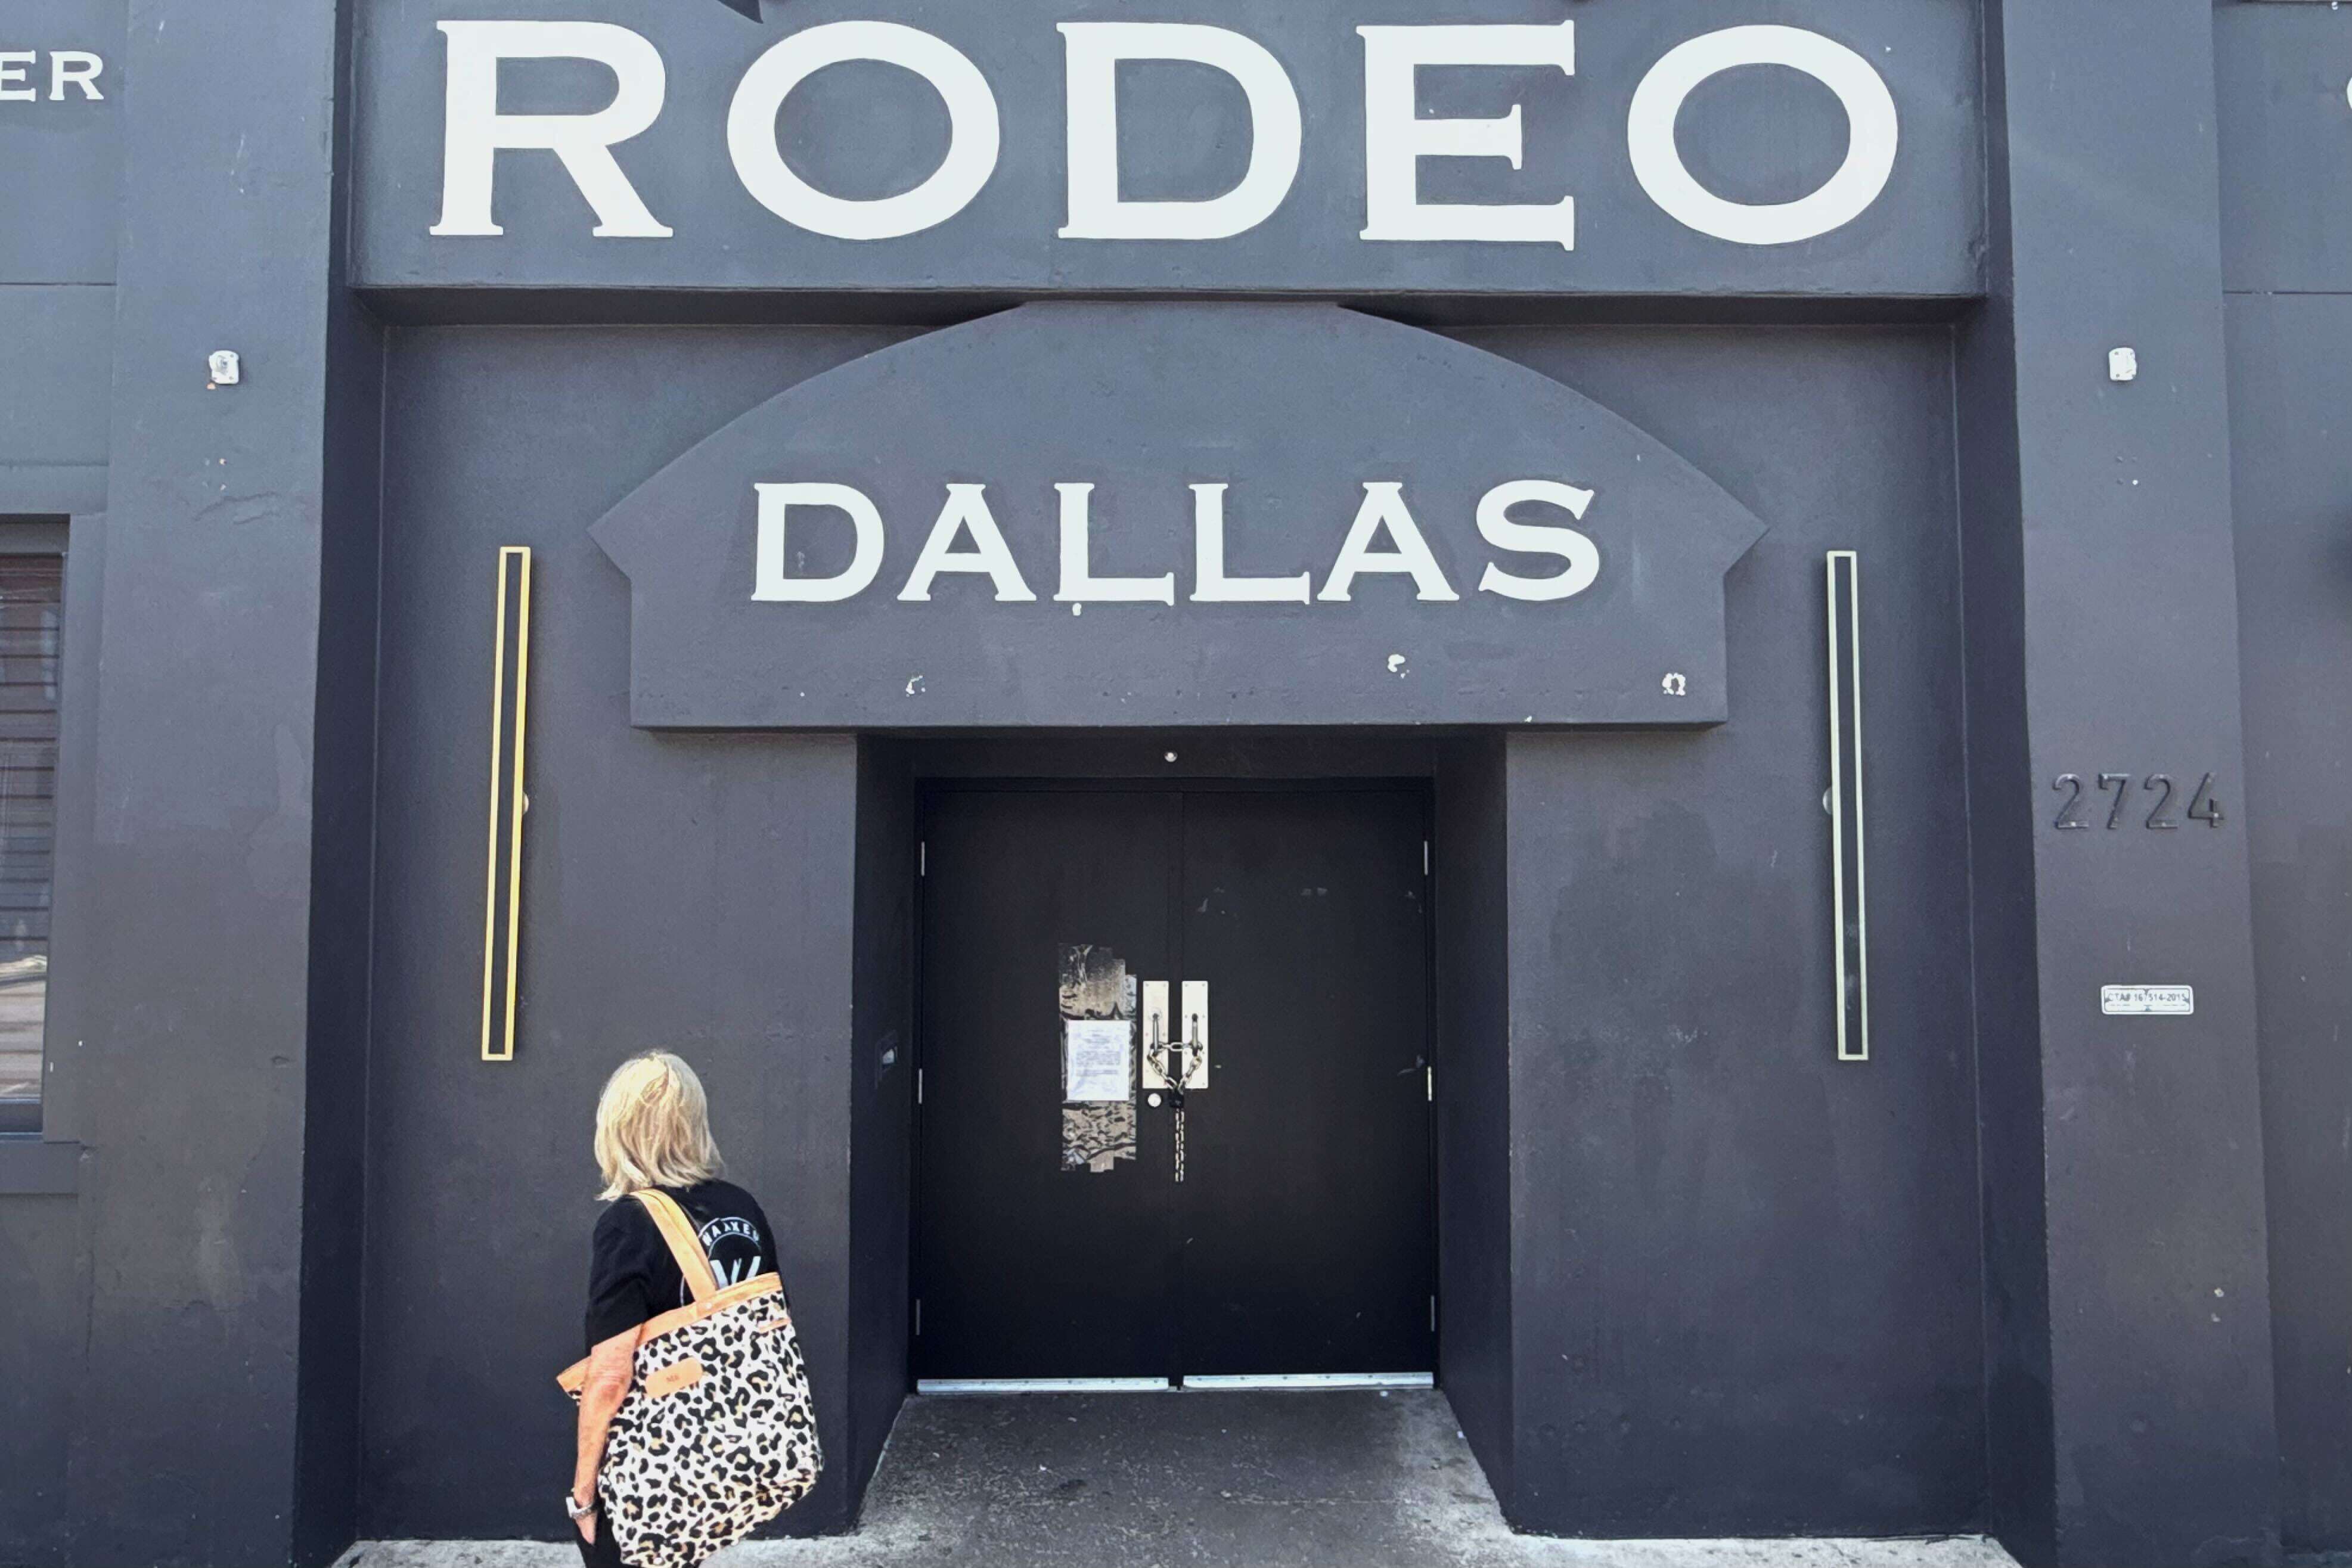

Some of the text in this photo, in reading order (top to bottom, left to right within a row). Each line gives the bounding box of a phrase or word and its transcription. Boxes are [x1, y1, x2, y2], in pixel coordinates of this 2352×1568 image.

[0, 50, 104, 101] ER
[430, 20, 1898, 250] RODEO
[751, 480, 1599, 606] DALLAS
[2053, 774, 2224, 829] 2724
